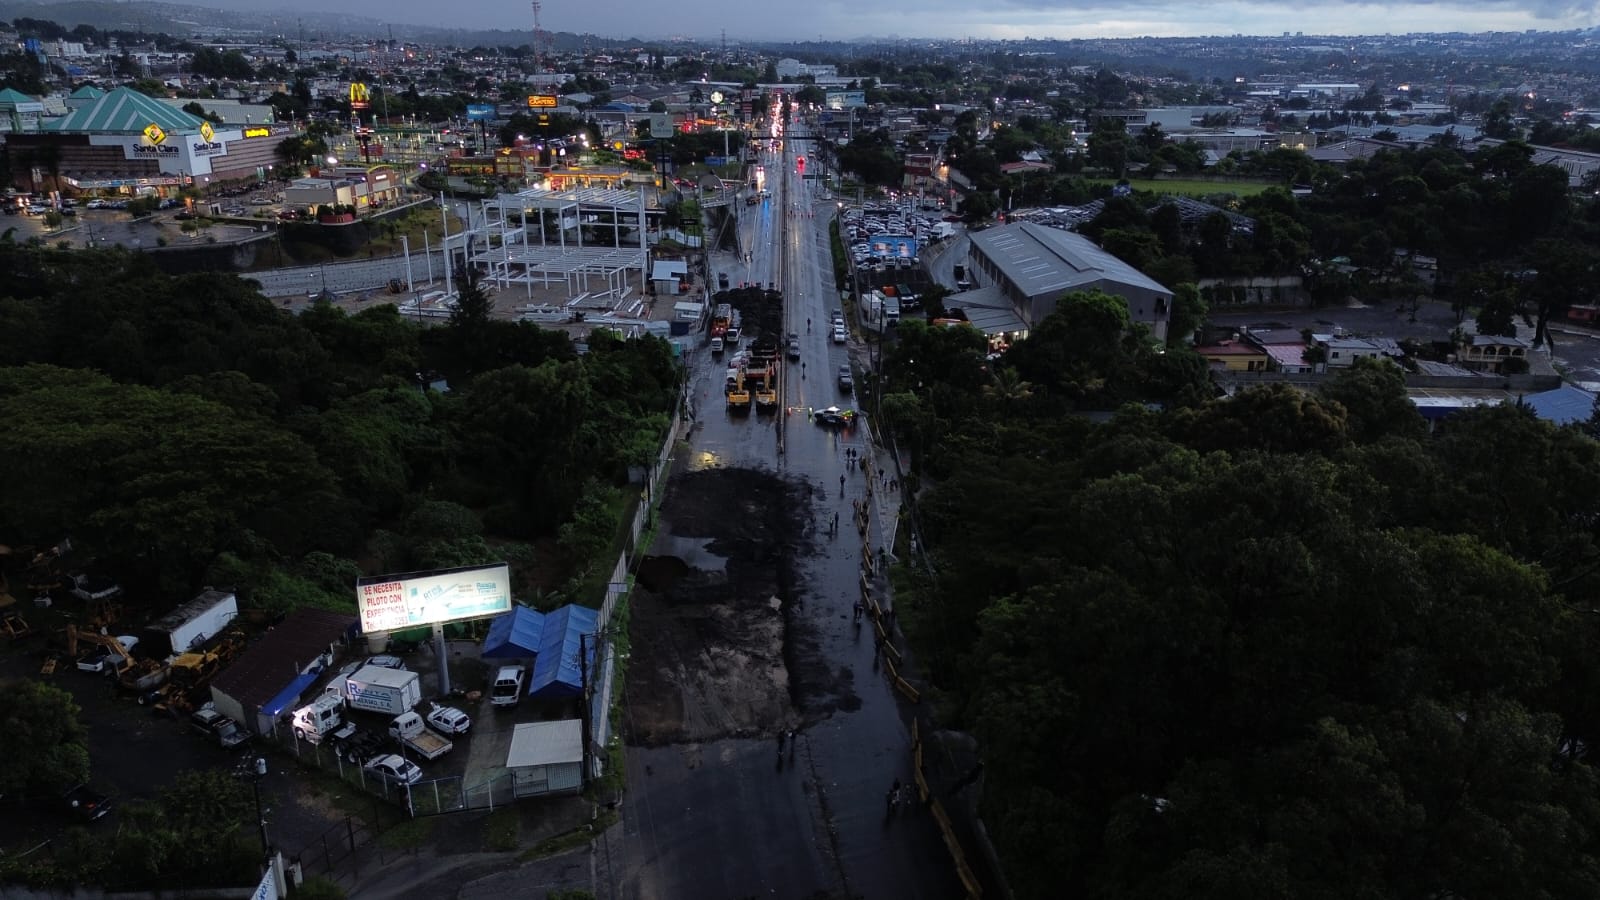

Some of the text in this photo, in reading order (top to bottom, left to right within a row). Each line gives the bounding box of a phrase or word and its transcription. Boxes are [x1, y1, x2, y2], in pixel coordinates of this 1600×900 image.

[133, 143, 179, 153] Santa Clara
[194, 143, 208, 151] Santa
[364, 582, 402, 595] SE NECESITA
[367, 593, 402, 607] PILOTO CON
[367, 605, 405, 618] EXPERENCIA
